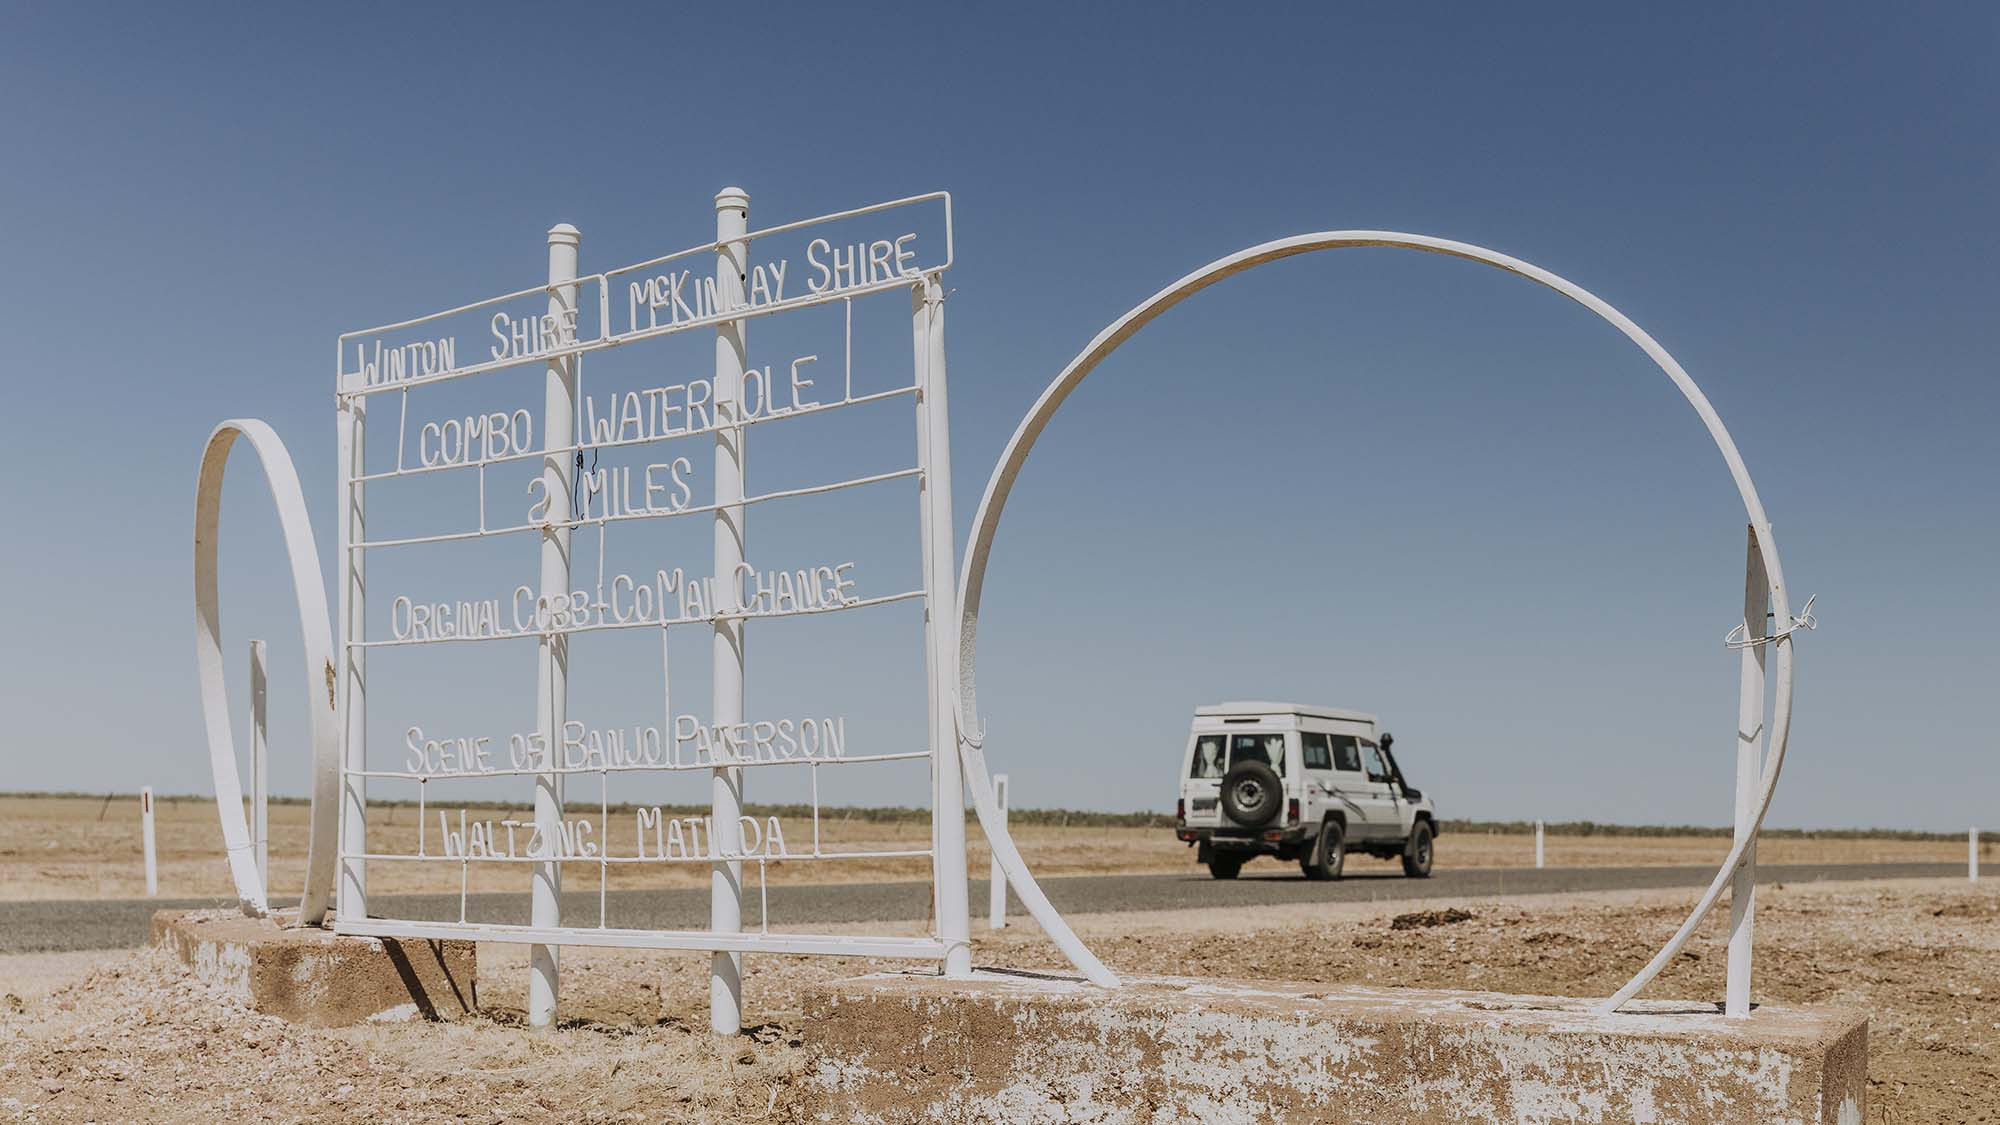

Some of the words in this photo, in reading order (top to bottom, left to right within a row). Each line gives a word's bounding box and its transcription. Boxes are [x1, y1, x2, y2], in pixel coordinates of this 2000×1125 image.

[807, 232, 920, 293] SHIRE
[358, 336, 455, 386] WINTON
[490, 308, 580, 361] SHIRE
[420, 408, 532, 467] COMBO
[586, 355, 820, 444] WATERHOLE
[527, 477, 551, 525] 2
[583, 456, 692, 520] MILES
[391, 595, 512, 641] ORIGINAL
[657, 568, 733, 623] MAIL
[734, 562, 859, 615] CHANGE
[406, 726, 495, 773] SCENE
[510, 732, 546, 770] OF
[563, 720, 661, 768] BANJO
[675, 714, 845, 767] PATERSON
[440, 809, 597, 859] WALTZING
[636, 807, 787, 859] MATILDA
